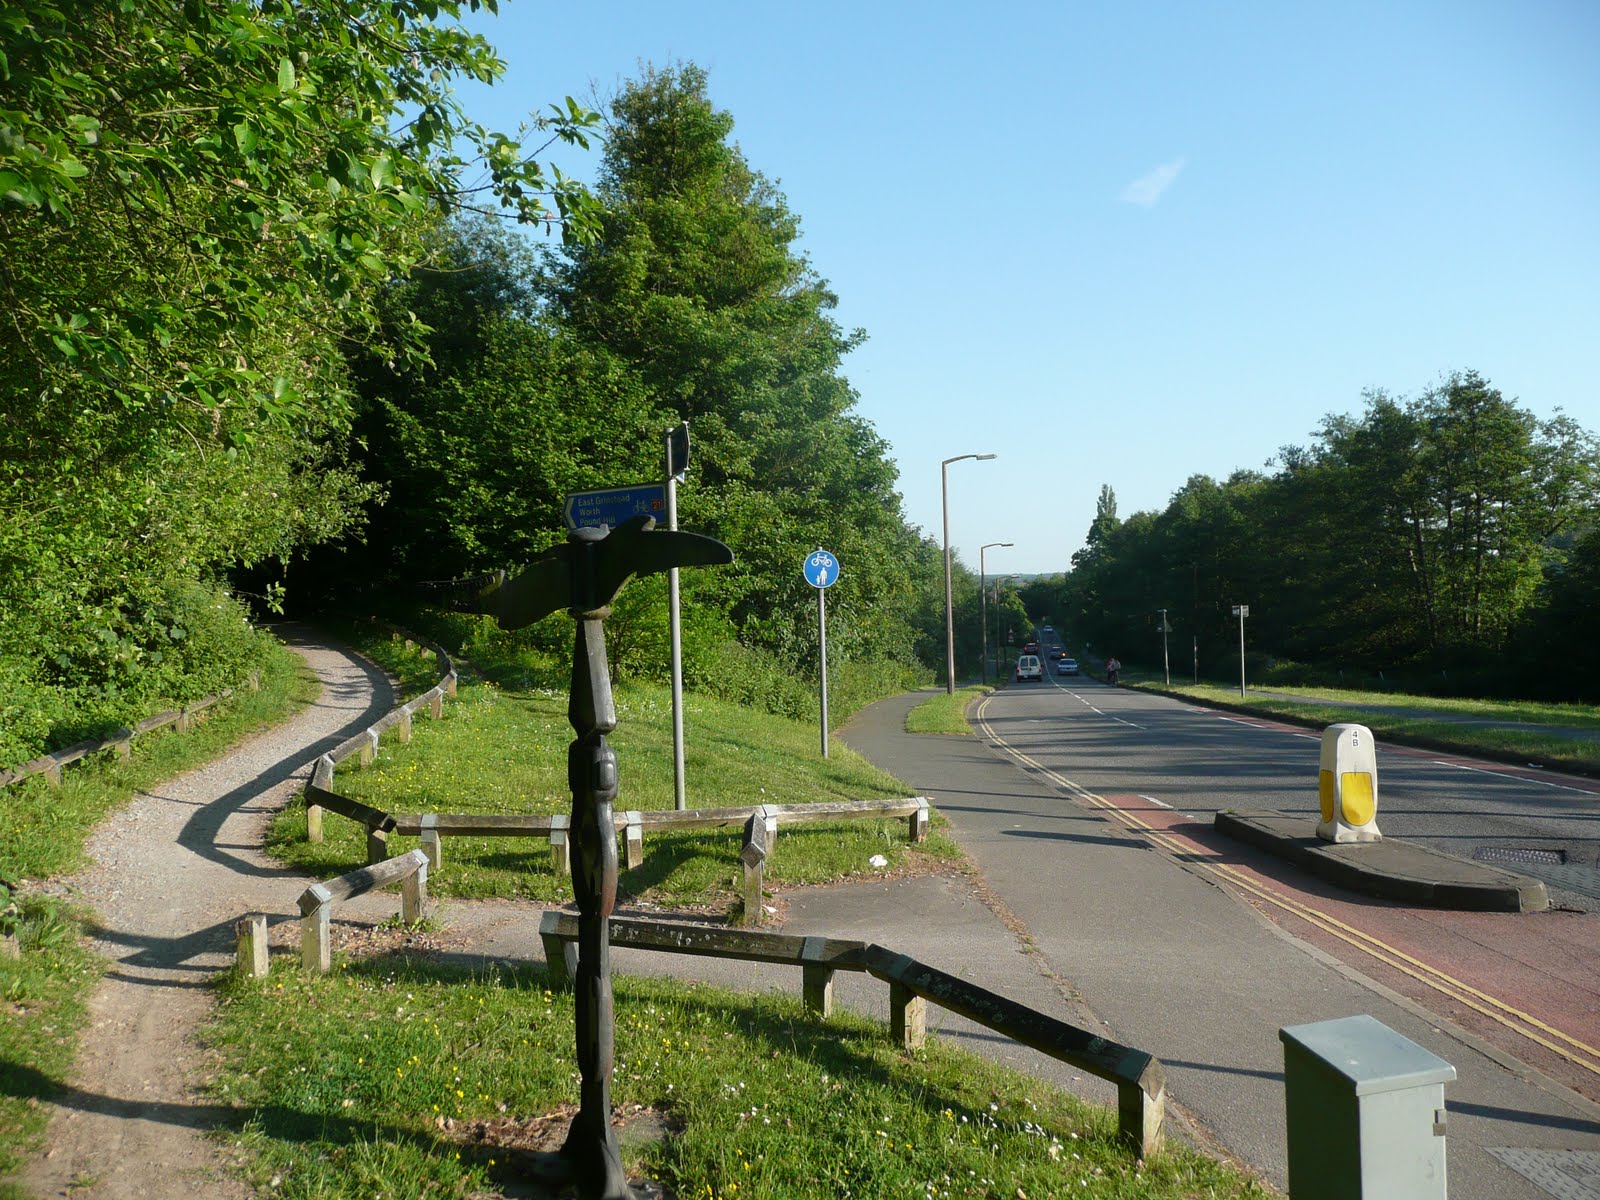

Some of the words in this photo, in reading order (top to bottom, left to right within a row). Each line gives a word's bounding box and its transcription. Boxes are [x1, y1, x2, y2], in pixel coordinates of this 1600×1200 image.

[577, 497, 594, 507] East
[579, 507, 600, 516] Worth
[579, 517, 601, 526] Pound
